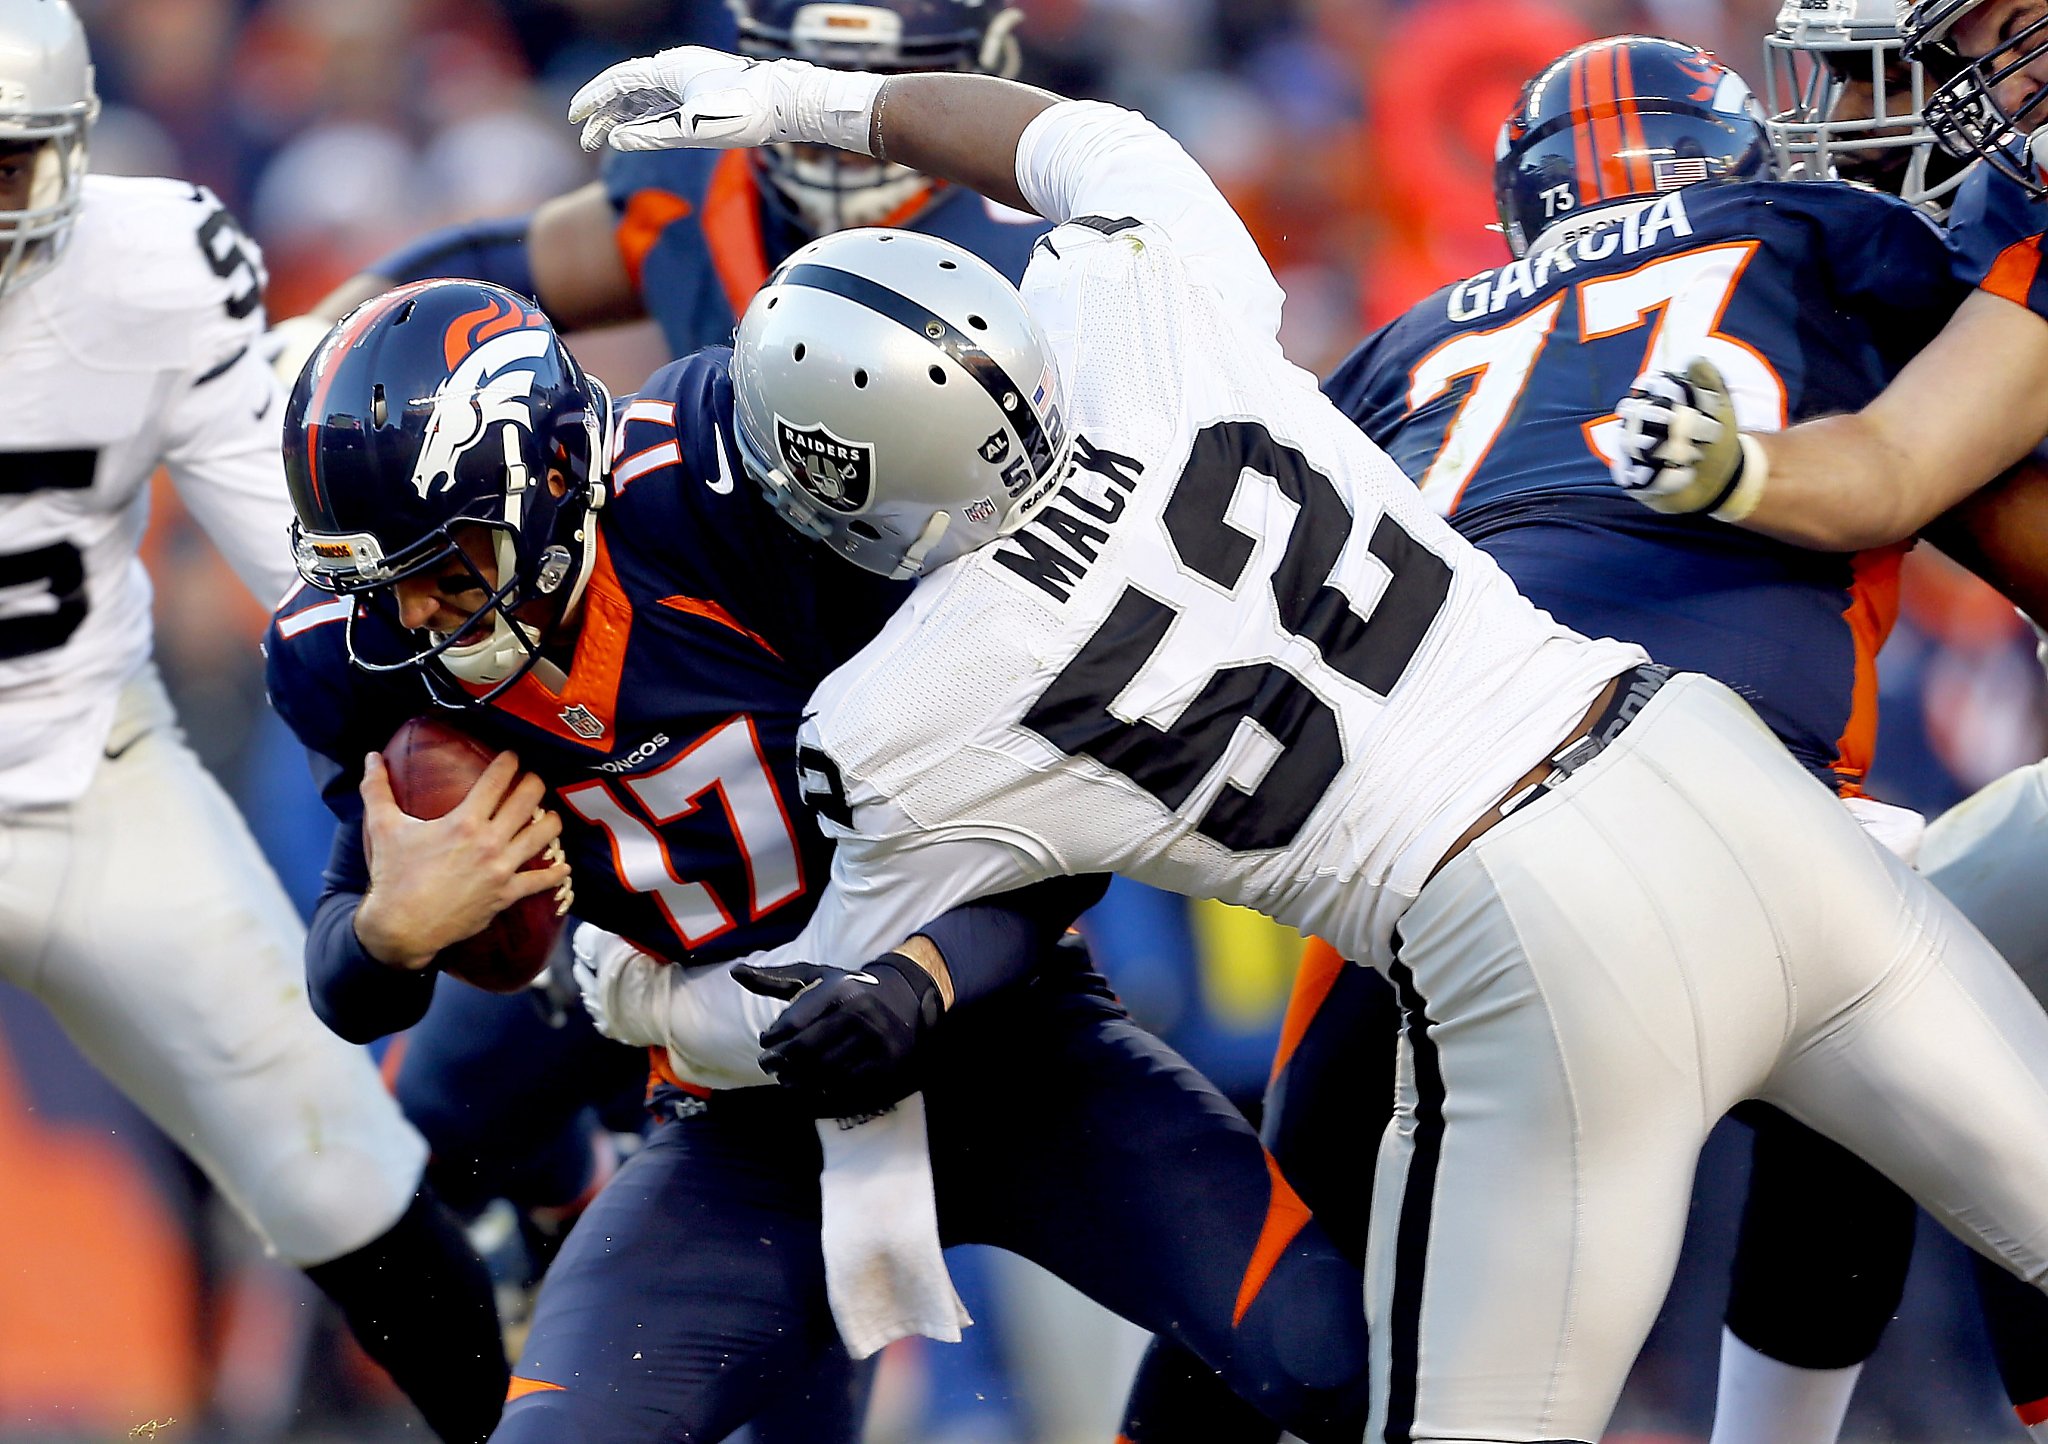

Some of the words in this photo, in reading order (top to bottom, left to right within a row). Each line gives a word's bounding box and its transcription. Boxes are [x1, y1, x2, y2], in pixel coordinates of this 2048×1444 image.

[1446, 190, 1694, 323] GARCIA
[1538, 183, 1576, 218] 73
[785, 427, 861, 461] RAIDERS
[1400, 240, 1789, 517] 73
[986, 436, 1008, 460] AL
[992, 433, 1145, 605] MACK
[1012, 415, 1457, 857] 52
[586, 732, 670, 773] ONCOS
[556, 711, 806, 949] 17
